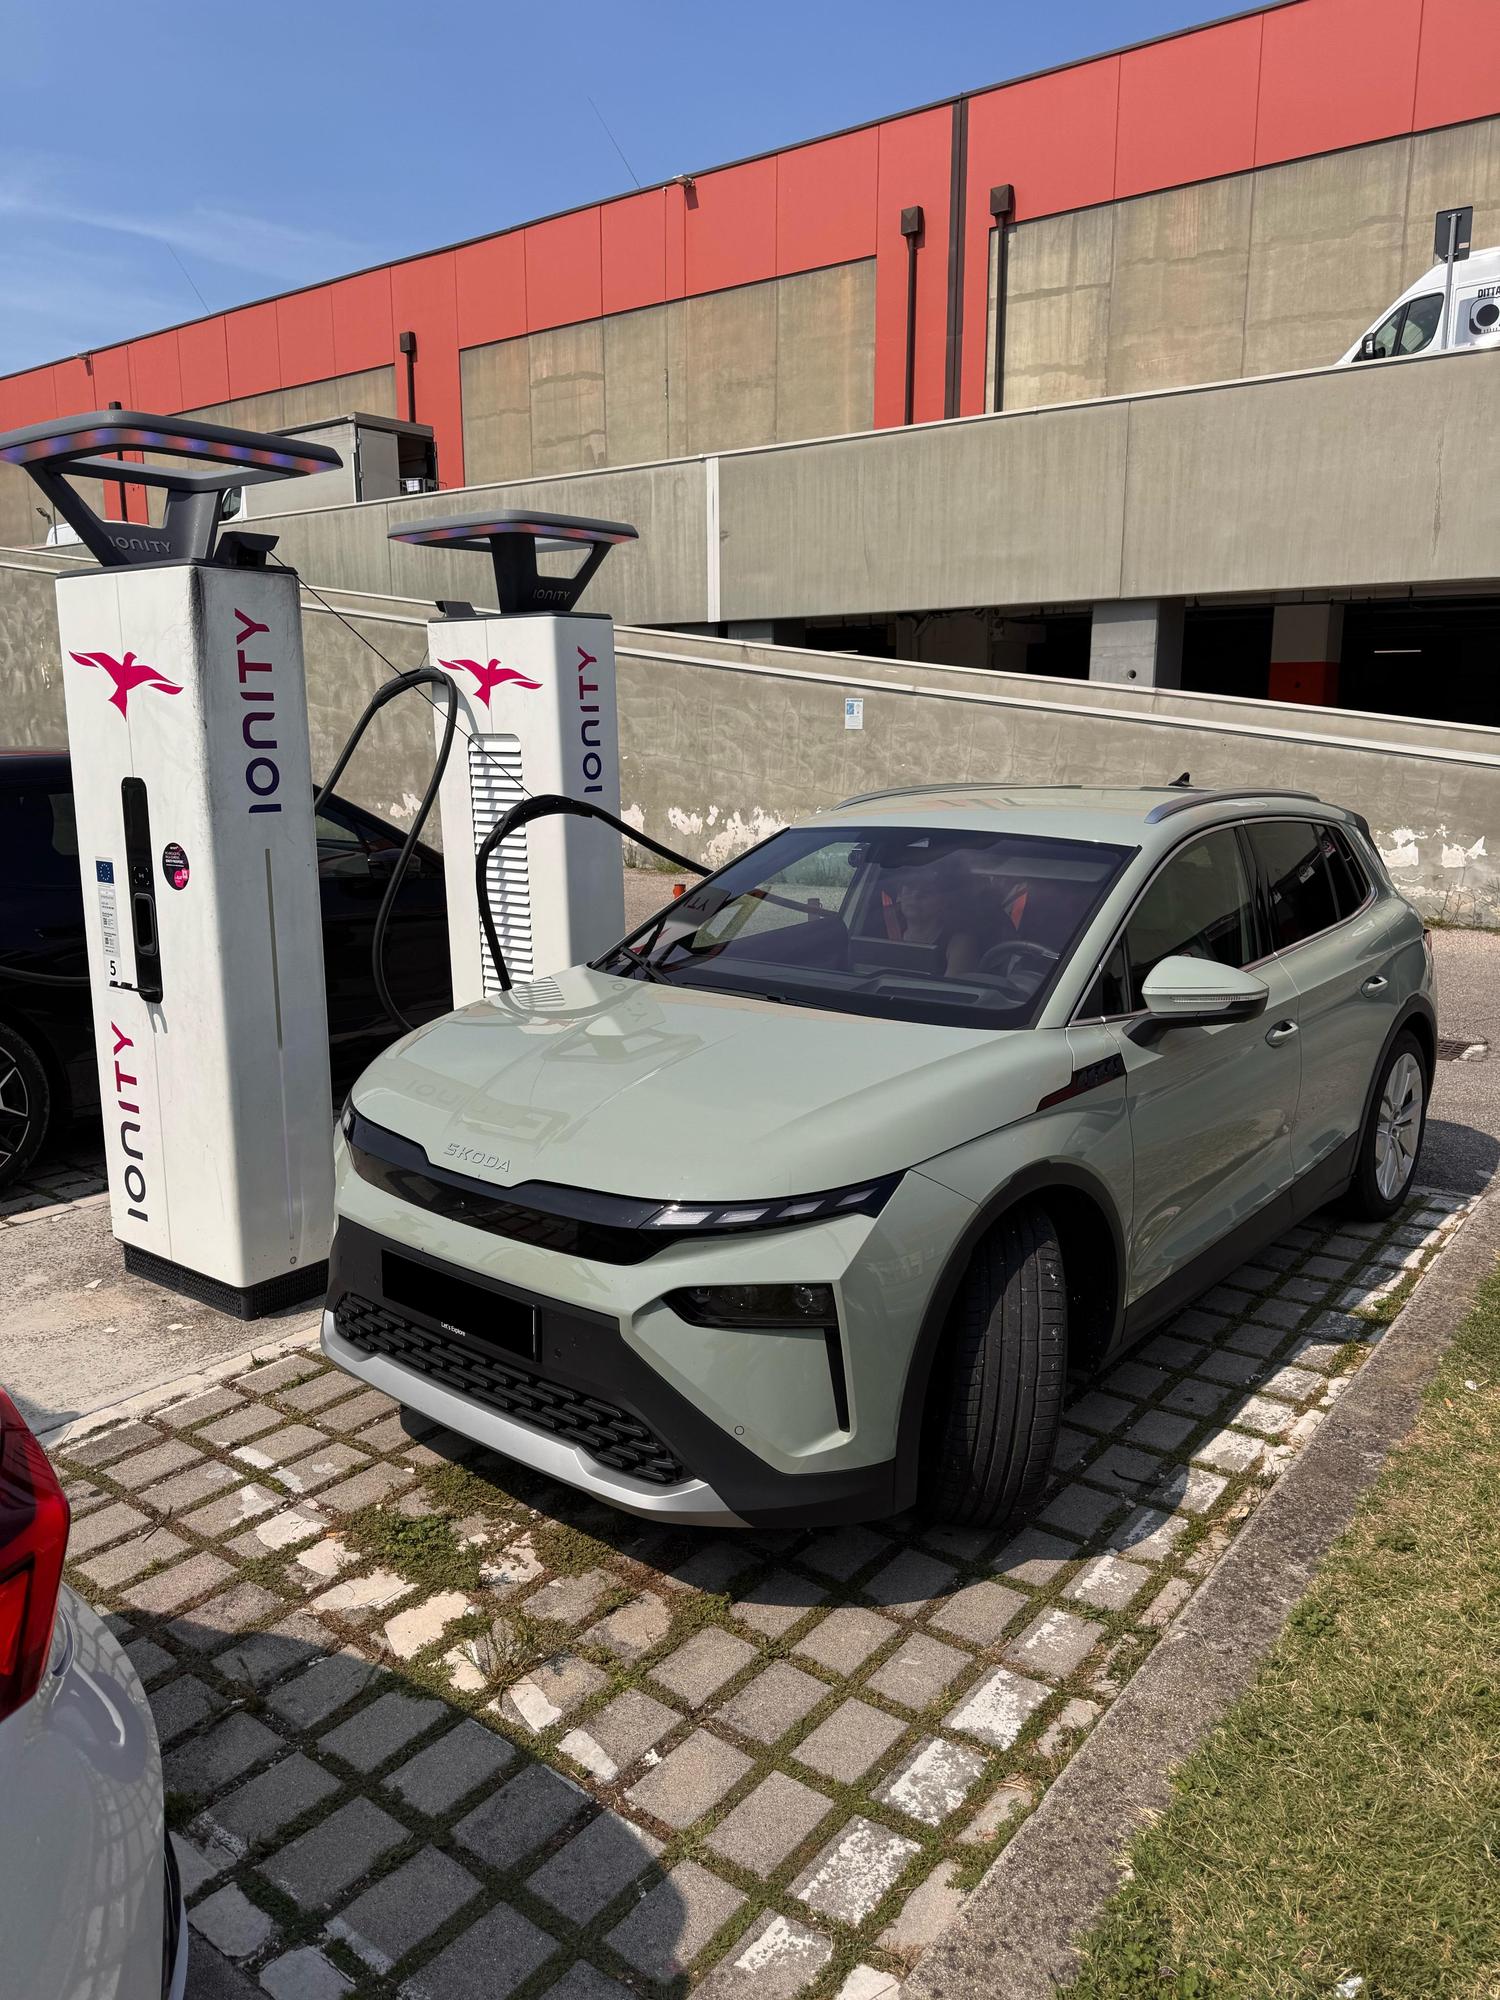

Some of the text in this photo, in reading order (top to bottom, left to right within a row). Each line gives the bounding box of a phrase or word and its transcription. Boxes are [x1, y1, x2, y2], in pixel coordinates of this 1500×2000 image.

[1477, 286, 1500, 298] DITTA
[108, 535, 171, 553] IONITY
[532, 588, 570, 600] IONITY
[234, 607, 282, 814] IONITY
[577, 646, 603, 793] IONITY
[109, 960, 117, 976] 5
[111, 1020, 149, 1222] IONITY
